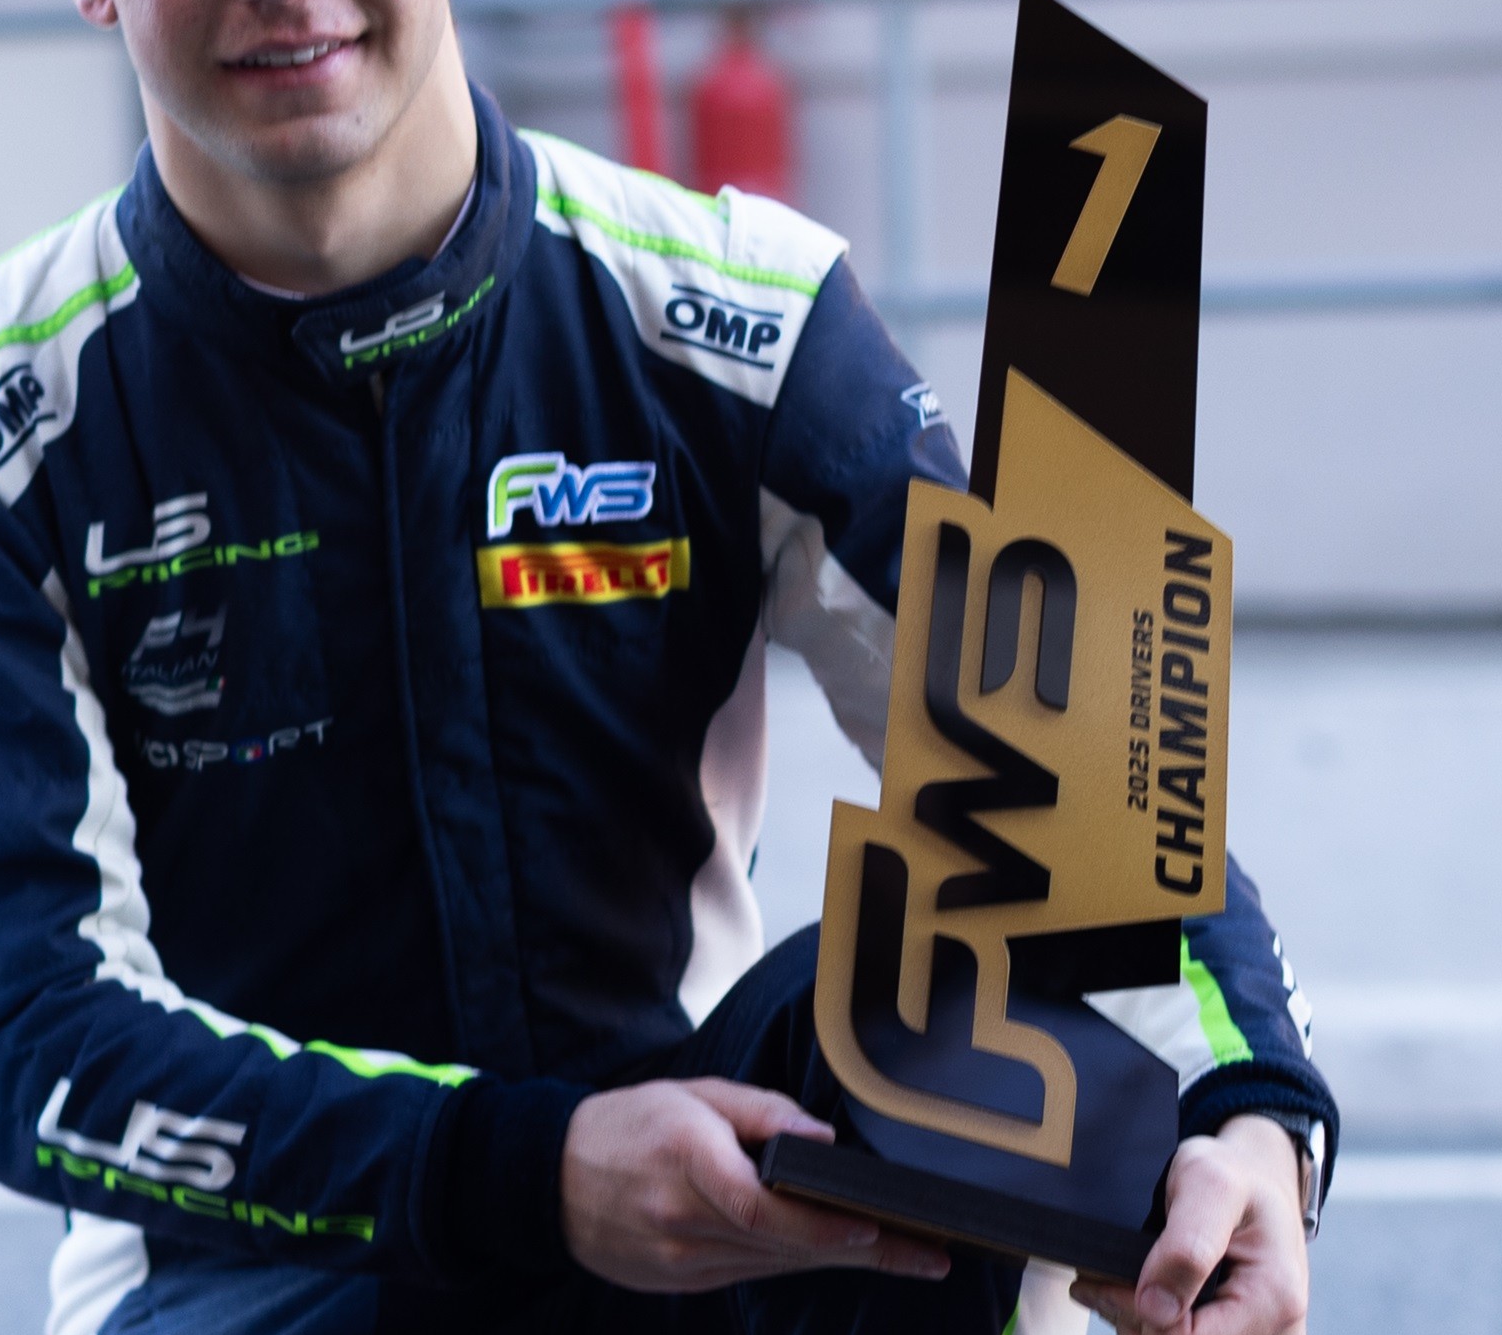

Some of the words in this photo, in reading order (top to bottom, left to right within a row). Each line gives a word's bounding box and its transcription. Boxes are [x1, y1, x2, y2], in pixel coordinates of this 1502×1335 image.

[1051, 114, 1163, 296] 1
[665, 297, 782, 355] OMP
[491, 457, 654, 534] FWS
[1129, 608, 1155, 733] DRIVERS
[1154, 528, 1214, 897] CHAMPION
[1127, 741, 1150, 813] 2025
